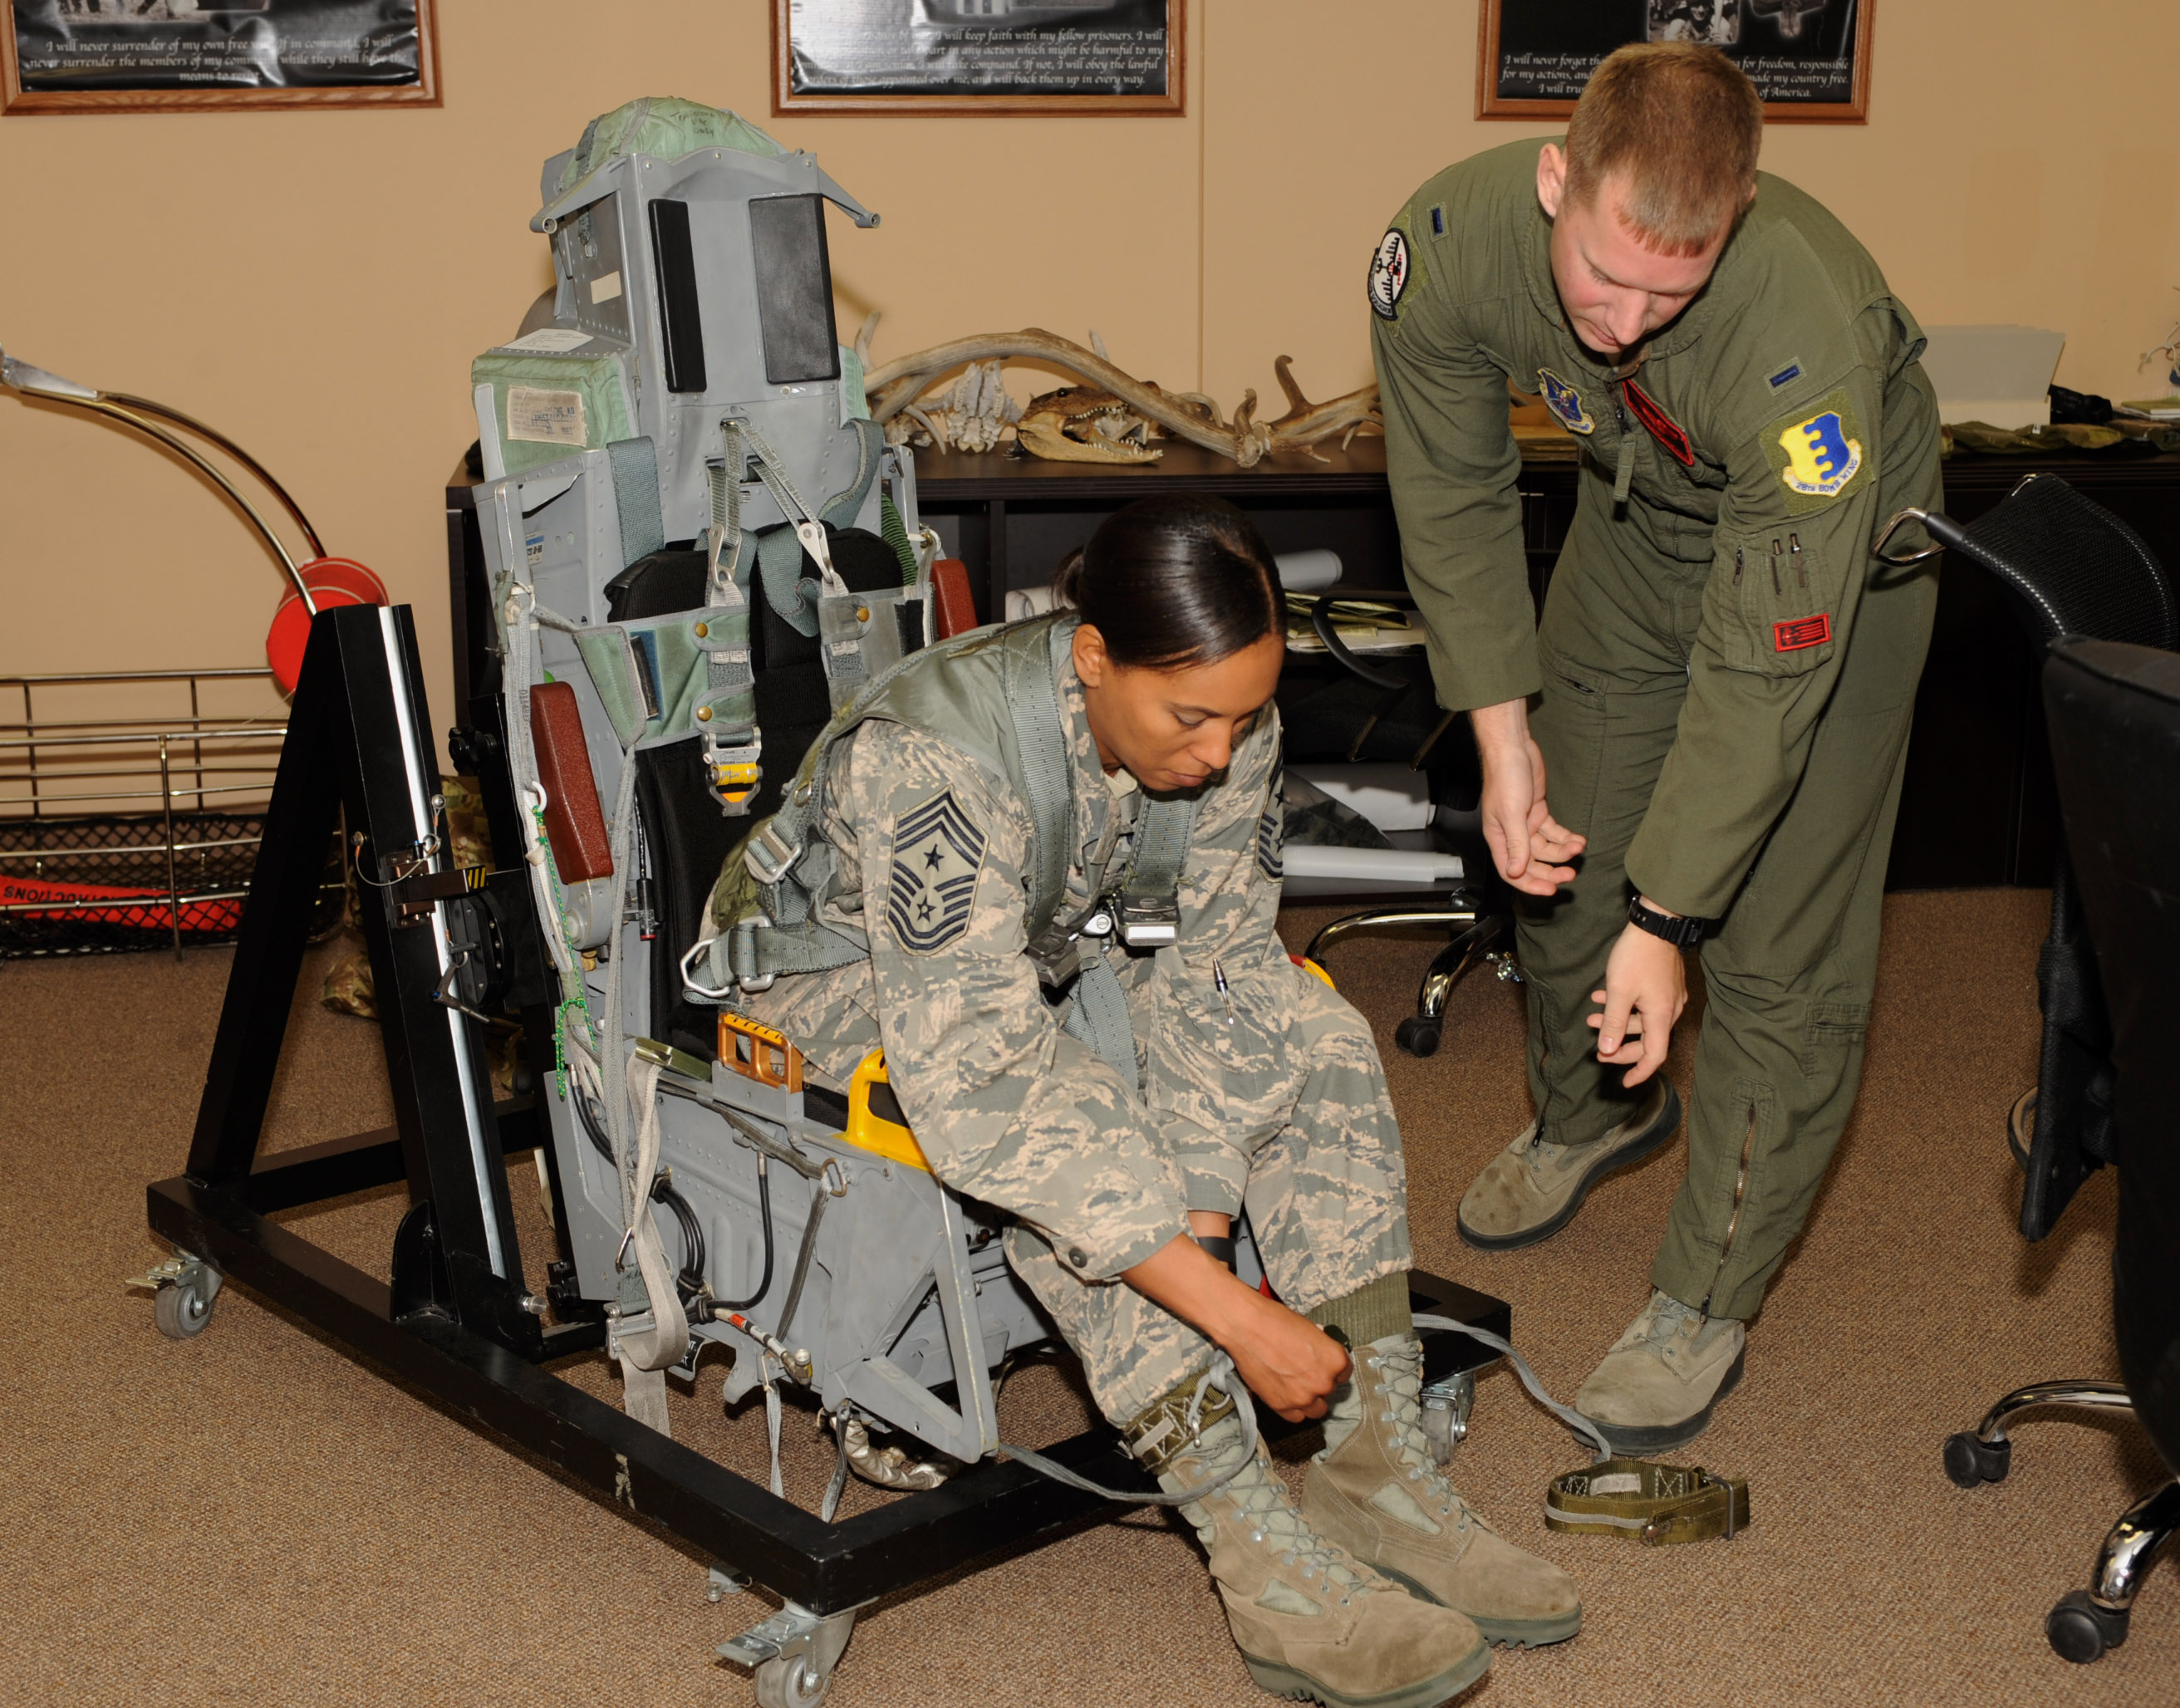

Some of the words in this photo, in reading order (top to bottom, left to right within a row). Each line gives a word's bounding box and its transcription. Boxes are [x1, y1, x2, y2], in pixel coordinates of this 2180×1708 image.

[46, 40, 53, 52] I
[56, 38, 79, 52] will
[80, 42, 107, 52] never
[112, 37, 166, 52] surrender
[169, 37, 181, 56] of
[182, 42, 200, 54] my
[203, 41, 225, 51] own
[224, 37, 248, 54] free
[291, 40, 302, 48] in
[371, 35, 393, 47] will
[945, 27, 964, 39] will
[965, 27, 985, 42] keep
[986, 28, 1012, 45] faith
[1015, 28, 1037, 40] with
[1040, 32, 1056, 45] my
[1057, 27, 1085, 45] fellow
[1088, 31, 1134, 45] prisoners.
[1137, 31, 1143, 41] I
[1145, 28, 1165, 40] will
[62, 54, 115, 67] surrender
[119, 53, 136, 66] the
[140, 54, 187, 67] members
[190, 52, 202, 71] of
[204, 57, 223, 71] my
[281, 52, 309, 64] while
[312, 52, 336, 69] they
[337, 50, 359, 64] still
[949, 47, 959, 55] in
[961, 47, 981, 59] any
[984, 45, 1014, 55] action
[1017, 43, 1045, 55] which
[1048, 43, 1077, 59] might
[1079, 42, 1091, 55] be
[1092, 42, 1133, 59] harmful
[1135, 45, 1146, 55] to
[1148, 47, 1164, 58] my
[970, 57, 1021, 69] command.
[1023, 58, 1035, 73] If
[1036, 61, 1054, 70] not,
[1057, 59, 1063, 69] I
[1065, 56, 1085, 69] will
[1085, 57, 1107, 73] obey
[1110, 57, 1125, 69] the
[1127, 57, 1158, 73] lawful
[1505, 54, 1511, 65] I
[1513, 52, 1533, 65] will
[1533, 56, 1558, 66] never
[1557, 52, 1587, 71] forget
[1741, 56, 1756, 71] for
[1755, 56, 1797, 73] freedom,
[1799, 57, 1849, 73] responsible
[877, 71, 928, 89] appointed
[930, 75, 950, 83] over
[953, 76, 970, 85] me,
[972, 72, 993, 84] and
[994, 71, 1013, 83] will
[1014, 71, 1037, 84] back
[1038, 71, 1063, 84] them
[1066, 75, 1079, 88] up
[1083, 73, 1092, 83] in
[1095, 75, 1121, 88] every
[1123, 76, 1146, 89] way.
[1499, 66, 1517, 83] for
[1519, 71, 1535, 84] my
[1536, 70, 1573, 81] actions,
[1773, 75, 1789, 88] my
[1790, 74, 1828, 89] country
[1826, 71, 1849, 89] free.
[1539, 83, 1544, 94] I
[1546, 81, 1567, 93] will
[1759, 85, 1770, 101] of
[1770, 86, 1812, 98] America.
[1819, 479, 1841, 493] BOMB
[1840, 459, 1858, 480] WING
